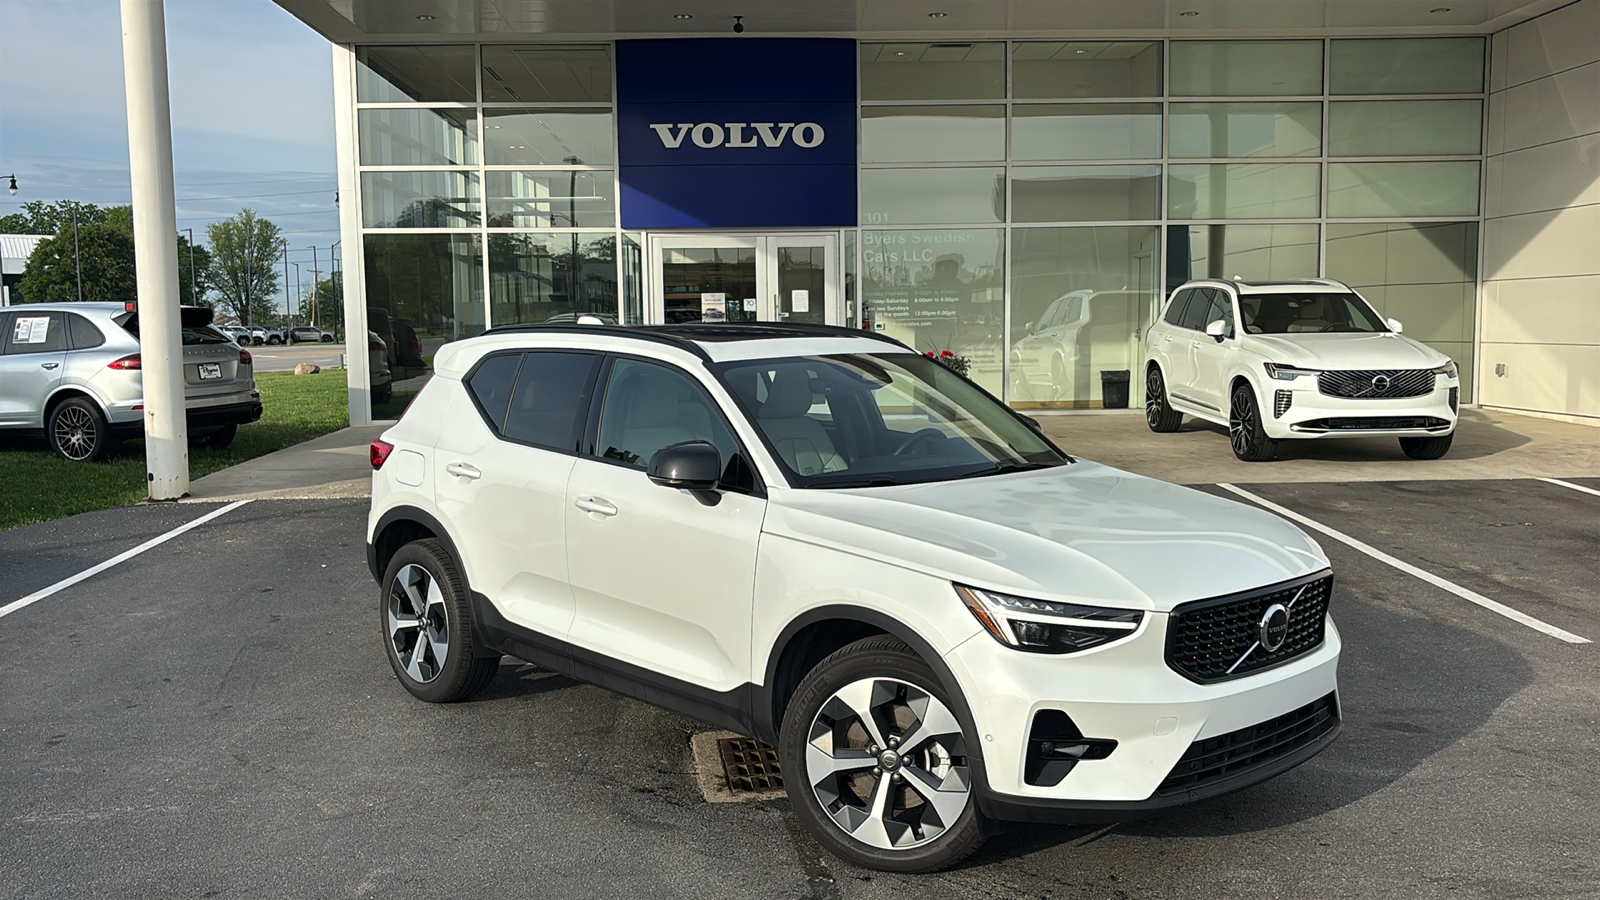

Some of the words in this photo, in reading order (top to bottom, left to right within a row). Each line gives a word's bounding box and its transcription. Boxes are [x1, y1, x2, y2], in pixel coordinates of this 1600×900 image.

[650, 122, 825, 148] VOLVO
[864, 212, 888, 224] 301
[864, 232, 906, 247] Byers
[912, 231, 974, 244] Swedish
[863, 249, 898, 263] Cars
[904, 249, 933, 262] LLC
